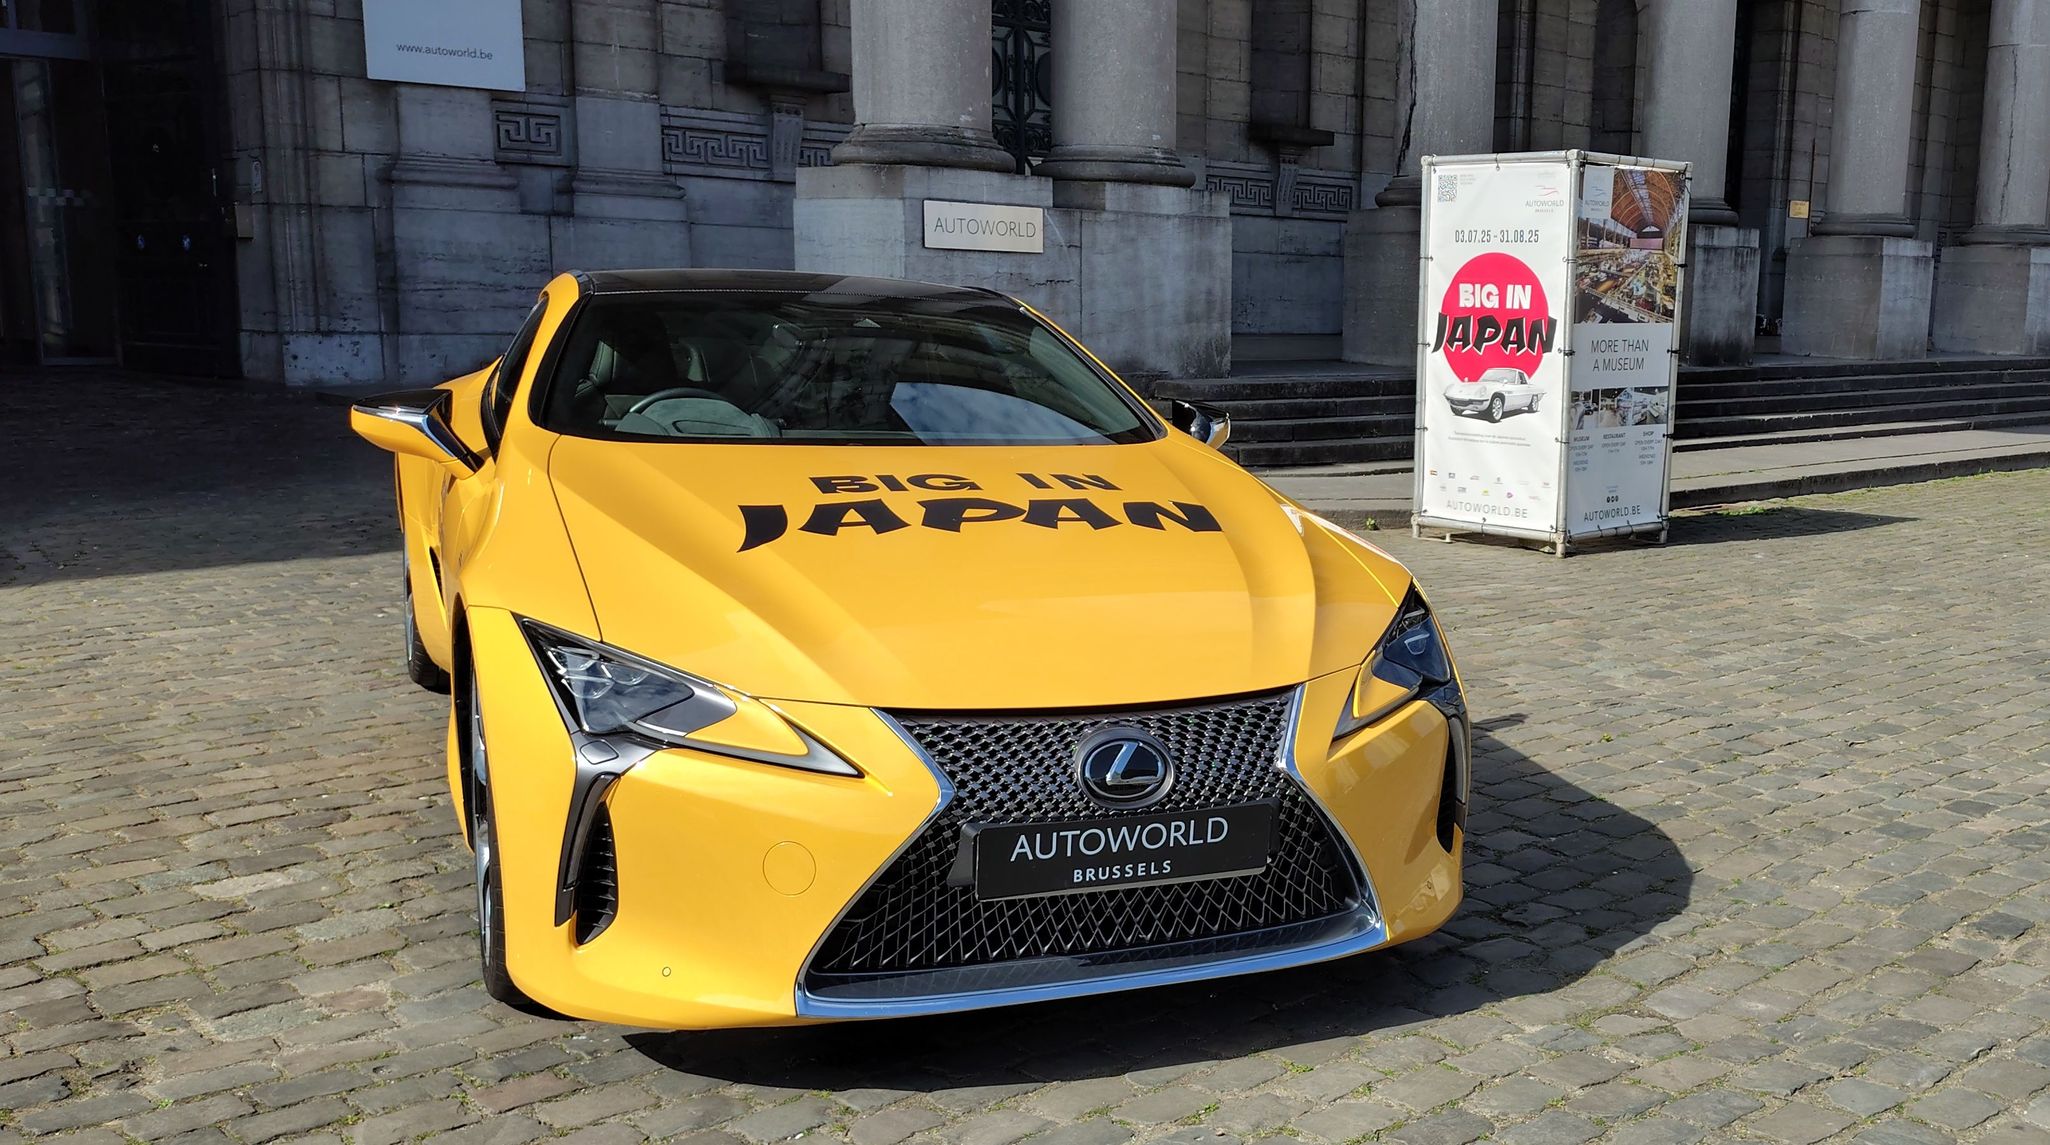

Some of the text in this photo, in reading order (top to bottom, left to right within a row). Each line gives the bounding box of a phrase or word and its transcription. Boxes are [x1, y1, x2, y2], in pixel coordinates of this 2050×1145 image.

[396, 43, 493, 60] www.autoworld.be
[934, 216, 1037, 238] AUTOWORLD
[1455, 229, 1491, 243] 03.07.25
[1499, 229, 1539, 243] 31.08.25
[1459, 283, 1532, 309] BIG IN
[1431, 312, 1557, 355] JAPAN
[1591, 339, 1649, 354] MORE THAN
[1593, 357, 1644, 372] A MUSEUM
[808, 472, 1124, 494] BIG IN
[1446, 499, 1528, 519] AUTOWORLD.BE
[1583, 504, 1641, 523] AUTOWORLD.BE
[736, 497, 1224, 553] JAPAN
[1010, 816, 1229, 862] AUTOWORLD
[1073, 860, 1172, 883] BRUSSELS
